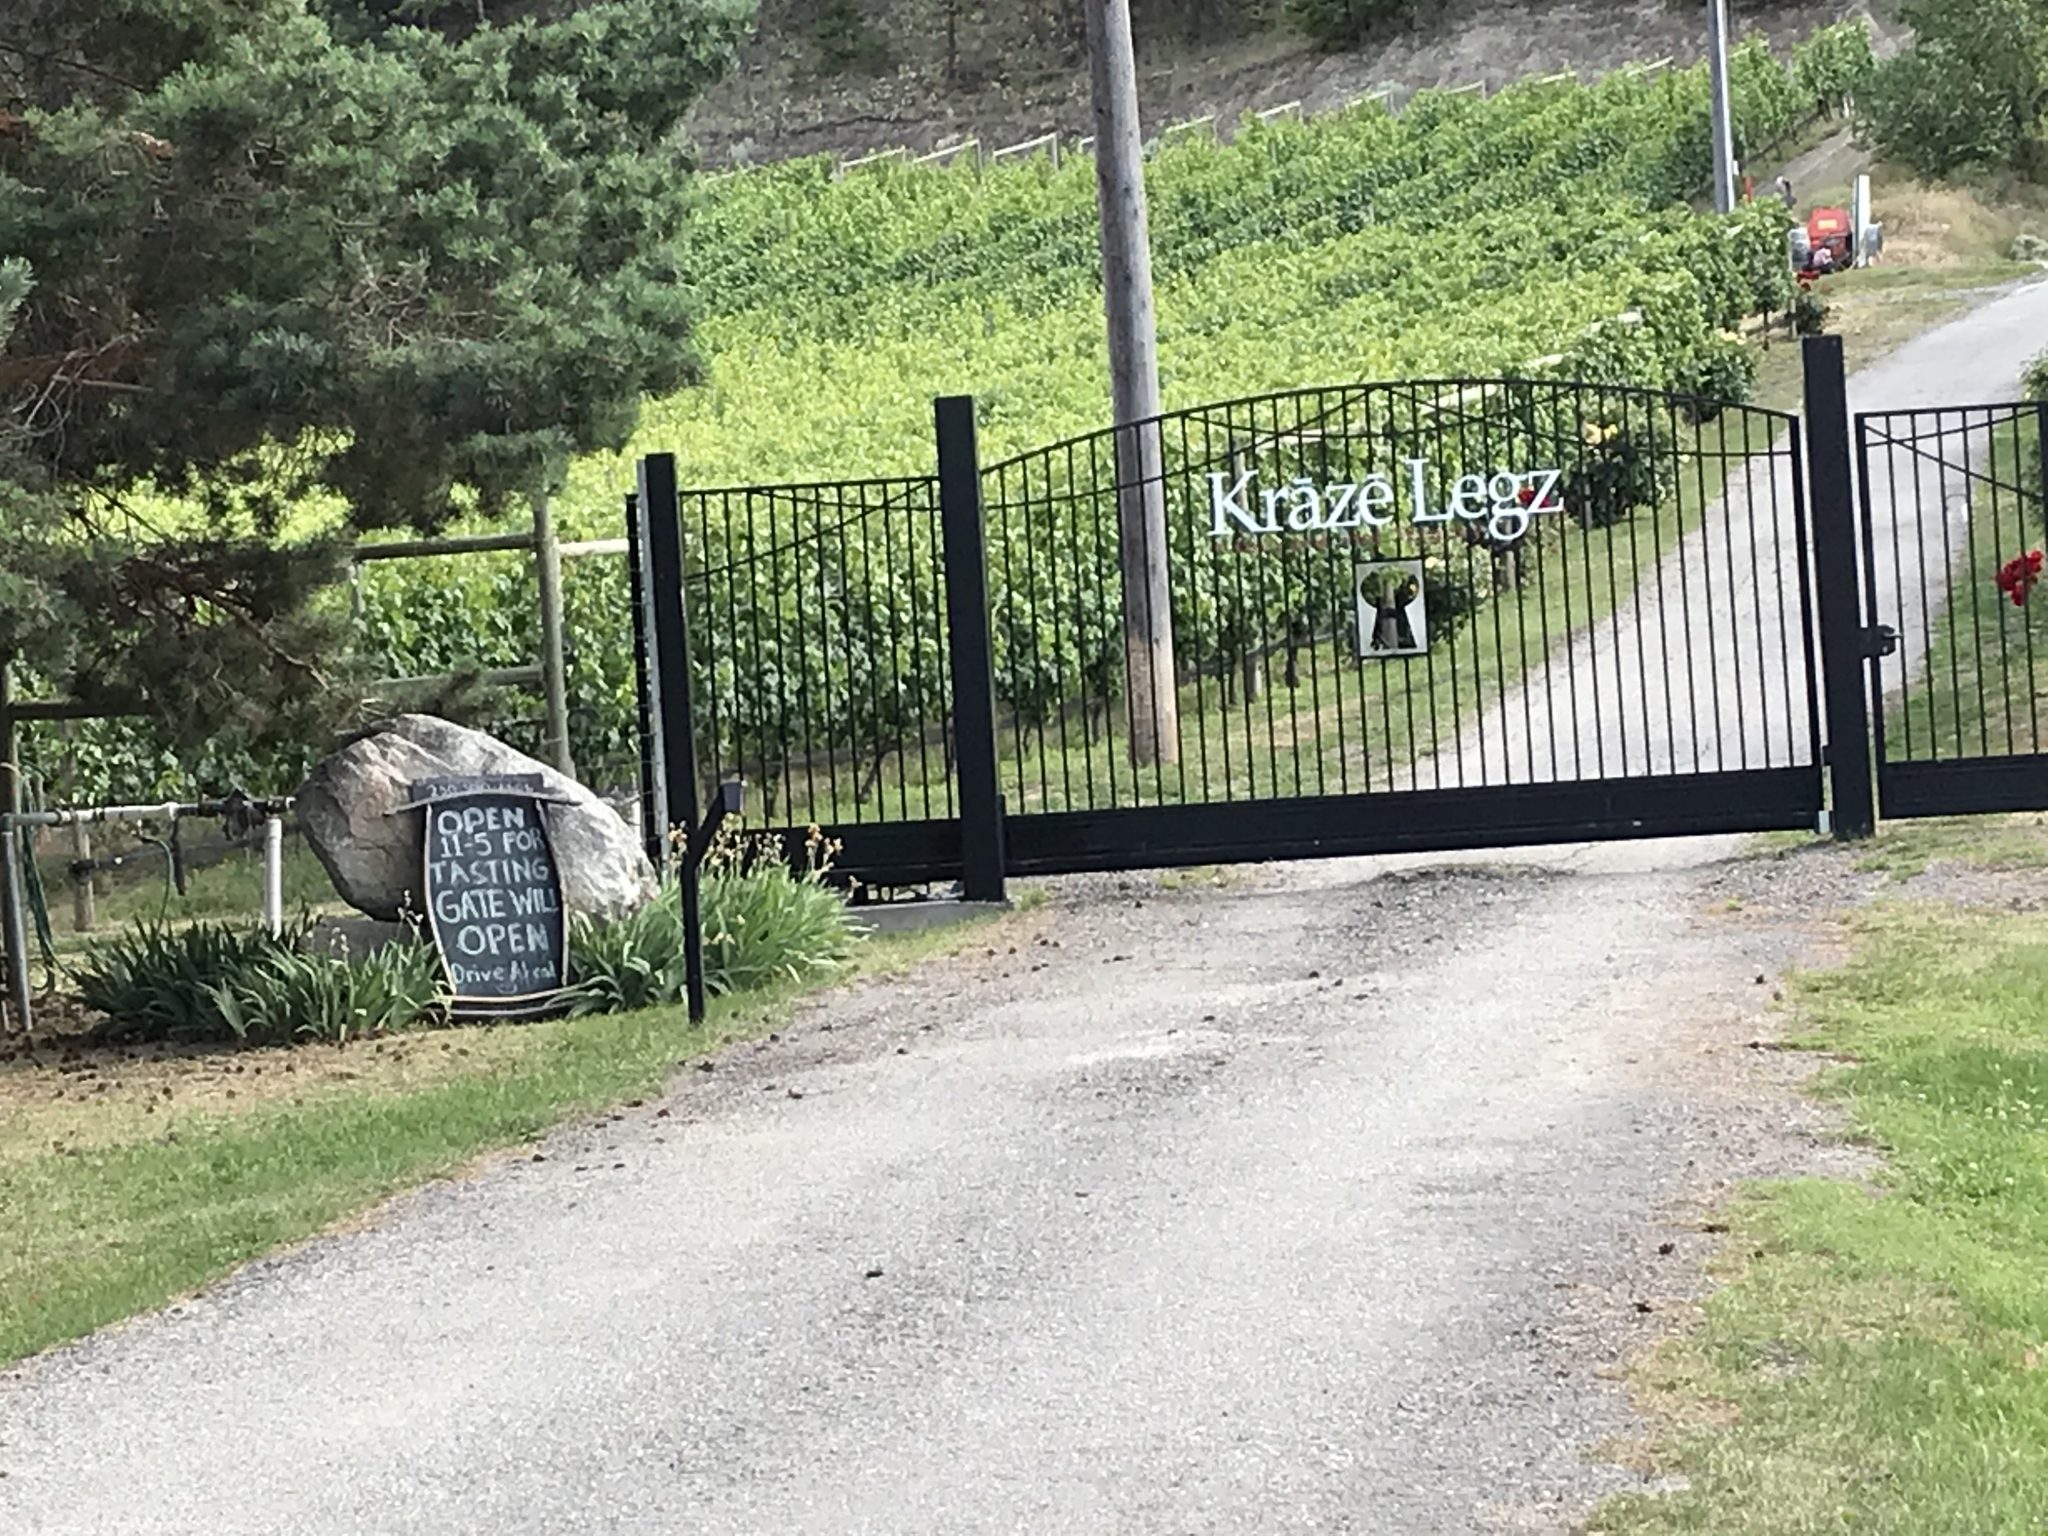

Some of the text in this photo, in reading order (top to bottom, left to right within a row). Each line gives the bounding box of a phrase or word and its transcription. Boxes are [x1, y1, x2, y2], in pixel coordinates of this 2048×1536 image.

[1206, 458, 1564, 541] Krāzē Legz
[438, 807, 525, 834] OPEN
[440, 828, 545, 858] 11-5 FOR
[430, 858, 549, 885] TASTING
[436, 887, 560, 923] GATE WILL
[457, 924, 548, 955] OPEN
[451, 963, 505, 985] Drive
